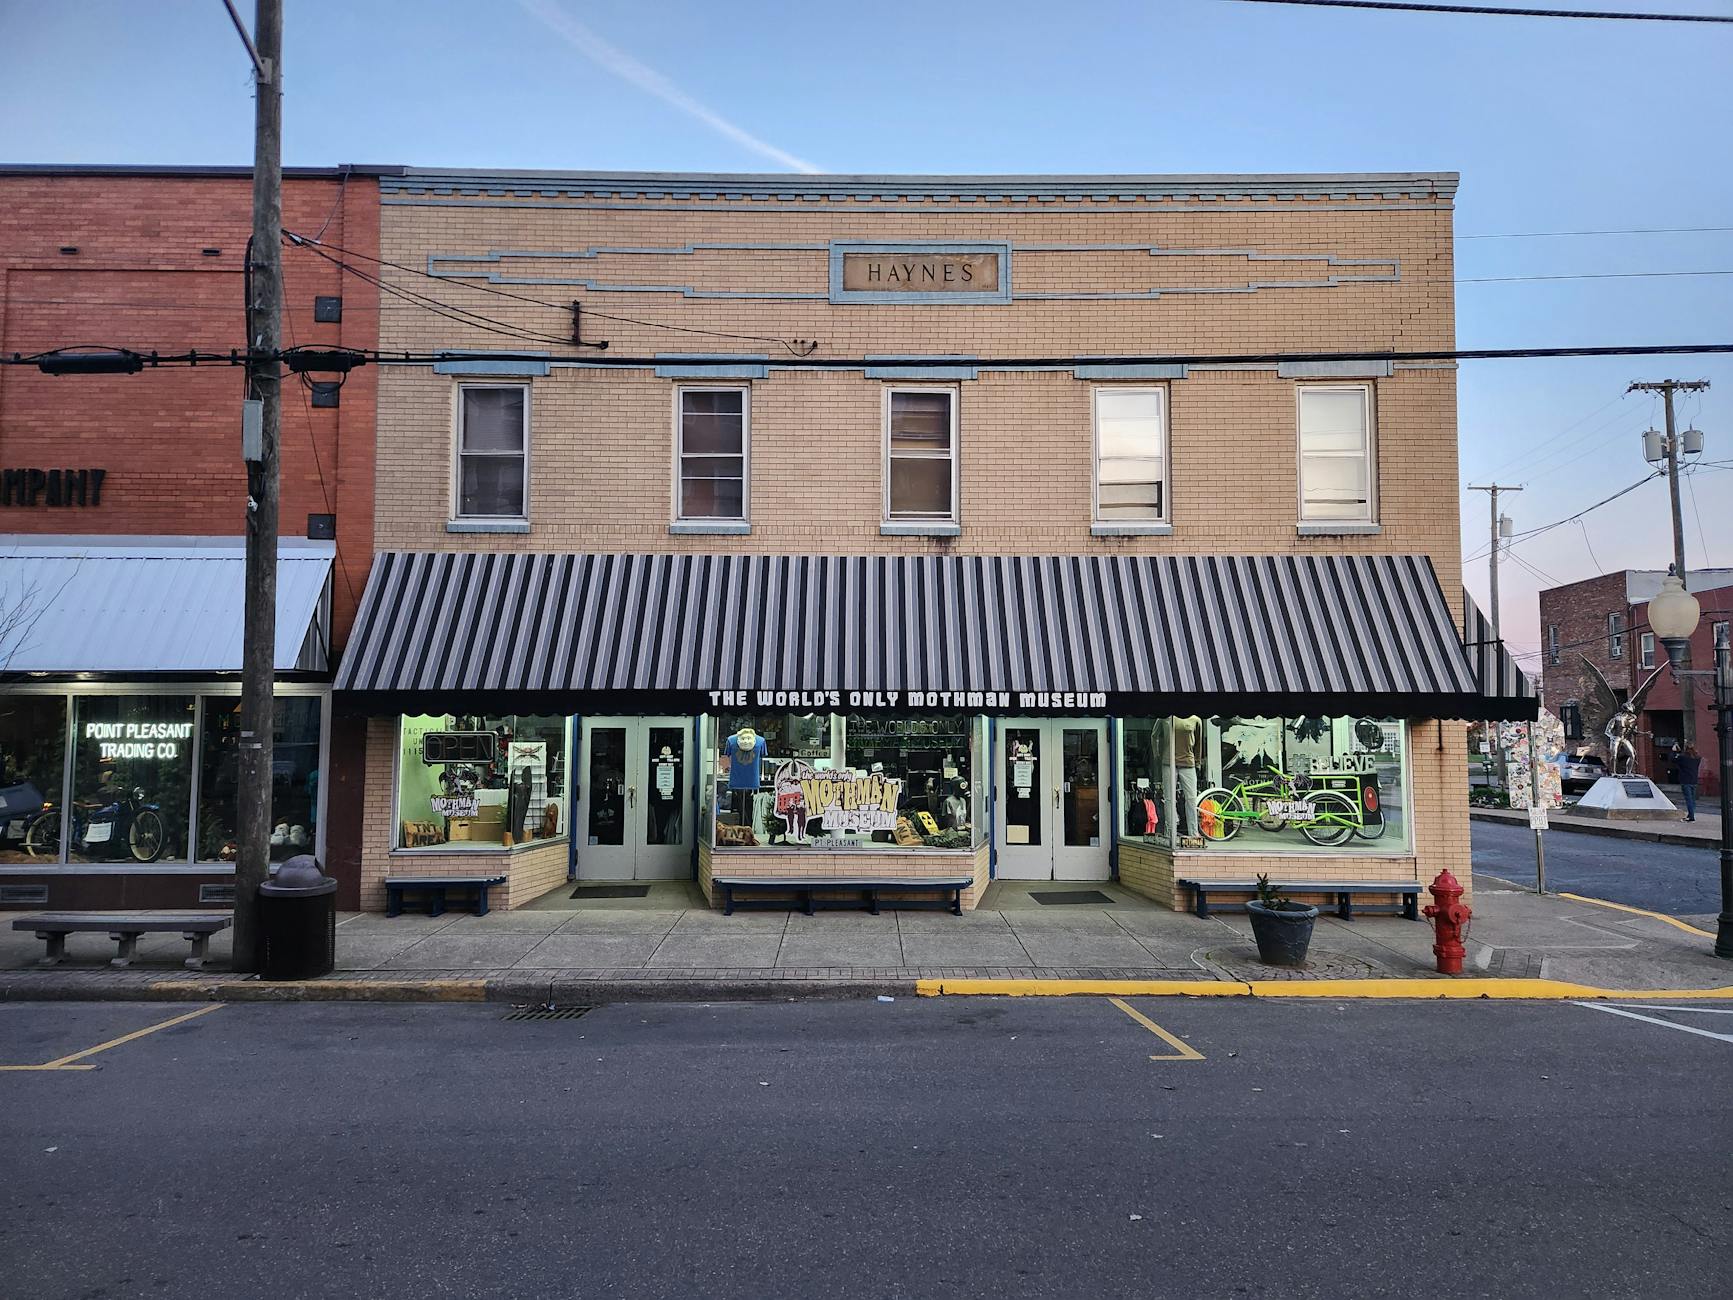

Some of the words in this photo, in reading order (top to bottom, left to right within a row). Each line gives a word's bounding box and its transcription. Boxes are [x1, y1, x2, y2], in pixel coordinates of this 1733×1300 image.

[867, 263, 974, 283] HAYNES
[0, 468, 106, 507] MPANY
[709, 690, 748, 706] THE
[756, 690, 840, 707] WORLD'S
[849, 691, 899, 707] ONLY
[86, 722, 125, 739] POINT
[126, 722, 193, 739] PLEASANT
[99, 742, 155, 759] TRADING
[156, 742, 178, 759] CO.
[427, 735, 493, 759] OPEN
[802, 771, 814, 780] the
[814, 769, 838, 780] world's
[837, 769, 854, 782] only
[431, 797, 480, 812] MOTHMAN
[801, 777, 899, 817] MOTHMAN
[1267, 800, 1316, 815] MOTHMAN
[823, 810, 897, 828] MUSEUM
[413, 824, 437, 833] TNT
